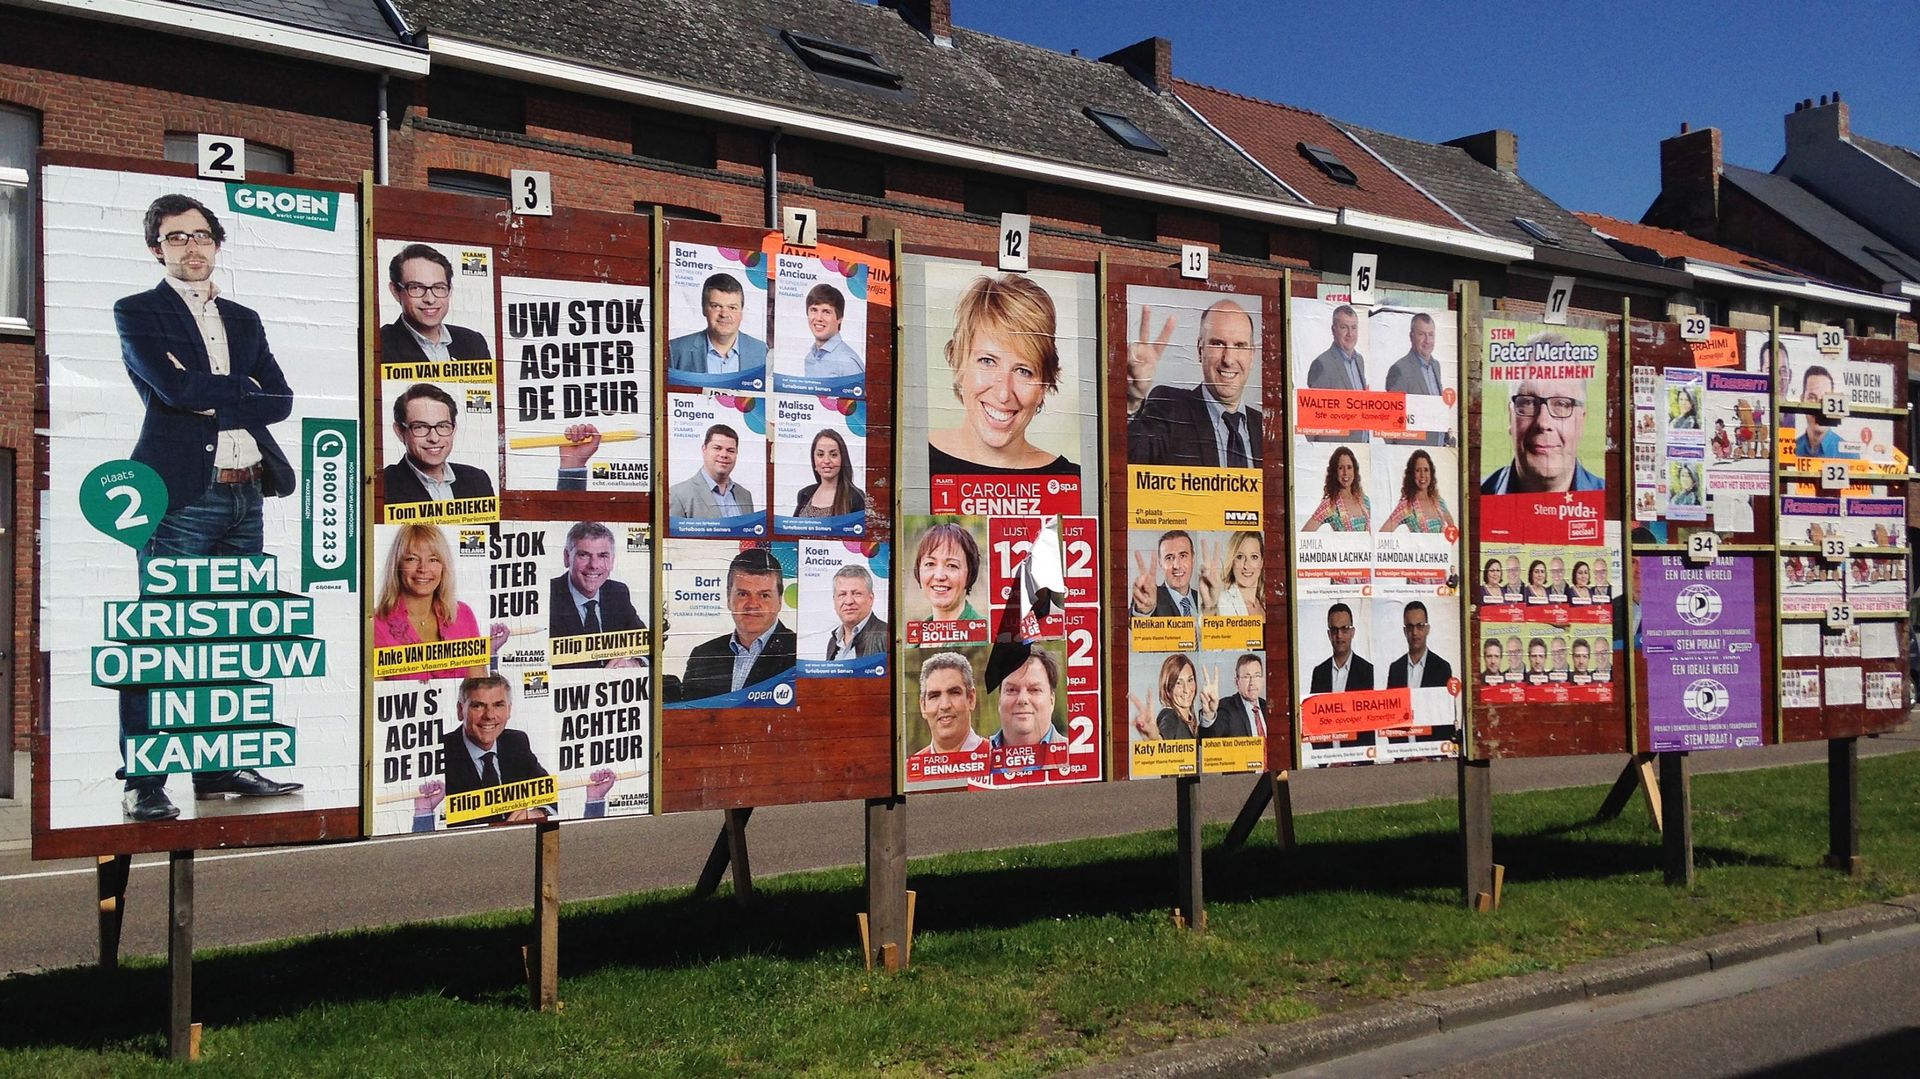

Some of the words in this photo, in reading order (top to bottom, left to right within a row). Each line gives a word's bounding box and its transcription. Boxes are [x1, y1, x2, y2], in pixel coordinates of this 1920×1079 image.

[208, 142, 235, 172] 2
[523, 176, 538, 209] 3
[234, 188, 329, 215] GROEN
[794, 213, 808, 244] 7
[1004, 229, 1022, 257] 12
[675, 247, 698, 259] Bart
[675, 257, 714, 271] Somers
[779, 258, 804, 269] Bavo
[1188, 253, 1202, 271] 13
[779, 268, 818, 281] Anciaux
[1356, 266, 1371, 292] 15
[1551, 289, 1567, 313] 17
[508, 301, 560, 338] UW
[568, 299, 646, 336] STOK
[1686, 319, 1706, 334] 29
[1490, 328, 1516, 340] STEM
[1822, 332, 1840, 346] 30
[1489, 341, 1533, 363] Peter
[1534, 340, 1600, 363] Mertens
[519, 340, 635, 381] ACHTER
[385, 366, 413, 380] Tom
[415, 363, 440, 379] VAN
[443, 361, 493, 378] GRIEKEN
[1490, 366, 1502, 380] IN
[1504, 366, 1527, 380] HET
[1528, 365, 1596, 380] PARLEMENT
[1843, 371, 1861, 387] VAN
[1863, 372, 1881, 388] DEN
[519, 386, 555, 422] DE
[563, 380, 639, 419] DEUR
[1851, 388, 1882, 404] BERGH
[673, 399, 694, 409] Tom
[778, 400, 815, 411] Malissa
[1299, 395, 1341, 410] WALTER
[1346, 397, 1405, 412] SCHROONS
[1827, 398, 1845, 412] 31
[673, 409, 715, 421] Ongena
[778, 410, 812, 421] Begtas
[1329, 412, 1358, 422] opvolger
[610, 463, 649, 472] VLAAMS
[1826, 466, 1846, 481] 32
[100, 470, 135, 487] plaats
[322, 462, 337, 503] 0800
[610, 471, 649, 481] BELANG
[1136, 471, 1177, 492] Marc
[1181, 472, 1258, 493] Hendrickx
[960, 482, 1041, 498] CAROLINE
[1060, 482, 1078, 493] sp.a
[1709, 481, 1728, 490] OMDAT
[1728, 481, 1739, 490] HET
[1739, 481, 1756, 490] BETER
[941, 491, 948, 505] 1
[104, 485, 149, 531] 2
[388, 506, 416, 521] Tom
[419, 503, 443, 518] VAN
[446, 498, 496, 515] GRIEKEN
[960, 498, 1041, 515] GENNEZ
[1144, 508, 1163, 517] plaats
[1533, 503, 1558, 516] Stem
[1558, 501, 1598, 520] pvda+
[322, 507, 337, 527] 23
[1135, 517, 1157, 525] Vlaams
[1157, 516, 1188, 526] Parlement
[1003, 526, 1029, 538] LIJST
[1571, 527, 1595, 537] sociaal
[322, 531, 337, 550] 23
[1298, 538, 1324, 550] JAMILA
[1376, 538, 1401, 550] JAMILA
[1693, 536, 1713, 552] 34
[1826, 540, 1845, 555] 33
[805, 546, 830, 556] Koen
[1299, 551, 1337, 563] HAMDDAN
[1376, 552, 1414, 563] HAMDDAN
[1415, 552, 1450, 564] LACHKAR
[322, 554, 337, 563] 3
[804, 556, 843, 567] Anciaux
[146, 557, 275, 594] STEM
[695, 575, 721, 587] Bart
[1665, 569, 1679, 581] EEN
[1680, 569, 1703, 581] IDEALE
[1704, 569, 1733, 581] WERELD
[674, 589, 721, 602] Somers
[1069, 588, 1086, 598] sp.a
[107, 600, 310, 638] KRISTOF
[1831, 606, 1850, 621] 35
[921, 621, 958, 632] SOPHIE
[1133, 619, 1165, 630] Melikan
[1166, 619, 1194, 629] Kucam
[1203, 617, 1224, 630] Freya
[1226, 617, 1261, 628] Perdaens
[910, 629, 917, 637] 4
[922, 630, 969, 642] BOLLEN
[552, 638, 582, 656] Filip
[585, 630, 650, 652] DEWINTER
[1676, 639, 1696, 650] STEM
[1696, 639, 1721, 650] PIRAAT
[377, 647, 403, 667] Anke
[404, 644, 424, 663] VAN
[425, 638, 487, 662] DERMEERSCH
[590, 651, 628, 660] Lijsttrekker
[95, 642, 322, 684] OPNIEUW
[421, 660, 448, 670] Vlaams
[449, 656, 487, 668] Parlement
[1672, 664, 1686, 675] EEN
[1687, 663, 1711, 675] IDEALE
[1711, 663, 1739, 675] WERELD
[1069, 676, 1087, 686] sp.a
[553, 685, 591, 714] UW
[595, 676, 650, 707] STOK
[747, 690, 773, 702] open
[150, 690, 195, 726] IN
[210, 687, 271, 724] DE
[377, 692, 418, 722] UW
[1311, 702, 1346, 716] JAMEL
[1352, 697, 1402, 713] IBRAHIMI
[560, 707, 641, 742] ACHTER
[1335, 715, 1363, 726] opvolger
[1203, 740, 1221, 749] Johan
[1222, 740, 1233, 748] Van
[1233, 738, 1262, 748] Overtveldt
[1331, 732, 1349, 741] Kamer
[1683, 734, 1702, 746] STEM
[1704, 733, 1728, 745] PIRAAT
[126, 731, 294, 774] KAMER
[559, 744, 585, 772] DE
[590, 734, 643, 766] DEUR
[1005, 746, 1037, 757] KAREL
[1134, 743, 1155, 757] Katy
[1158, 740, 1195, 754] Mariens
[923, 755, 949, 765] FARID
[994, 755, 1001, 763] 9
[1005, 755, 1036, 767] GEYS
[383, 756, 412, 784] DE
[911, 762, 920, 771] 21
[923, 762, 985, 776] BENNASSER
[1070, 764, 1087, 774] sp.a
[449, 794, 481, 813] Filip
[484, 777, 555, 806] DEWINTER
[531, 796, 555, 806] Kamer
[620, 799, 649, 807] BELANG
